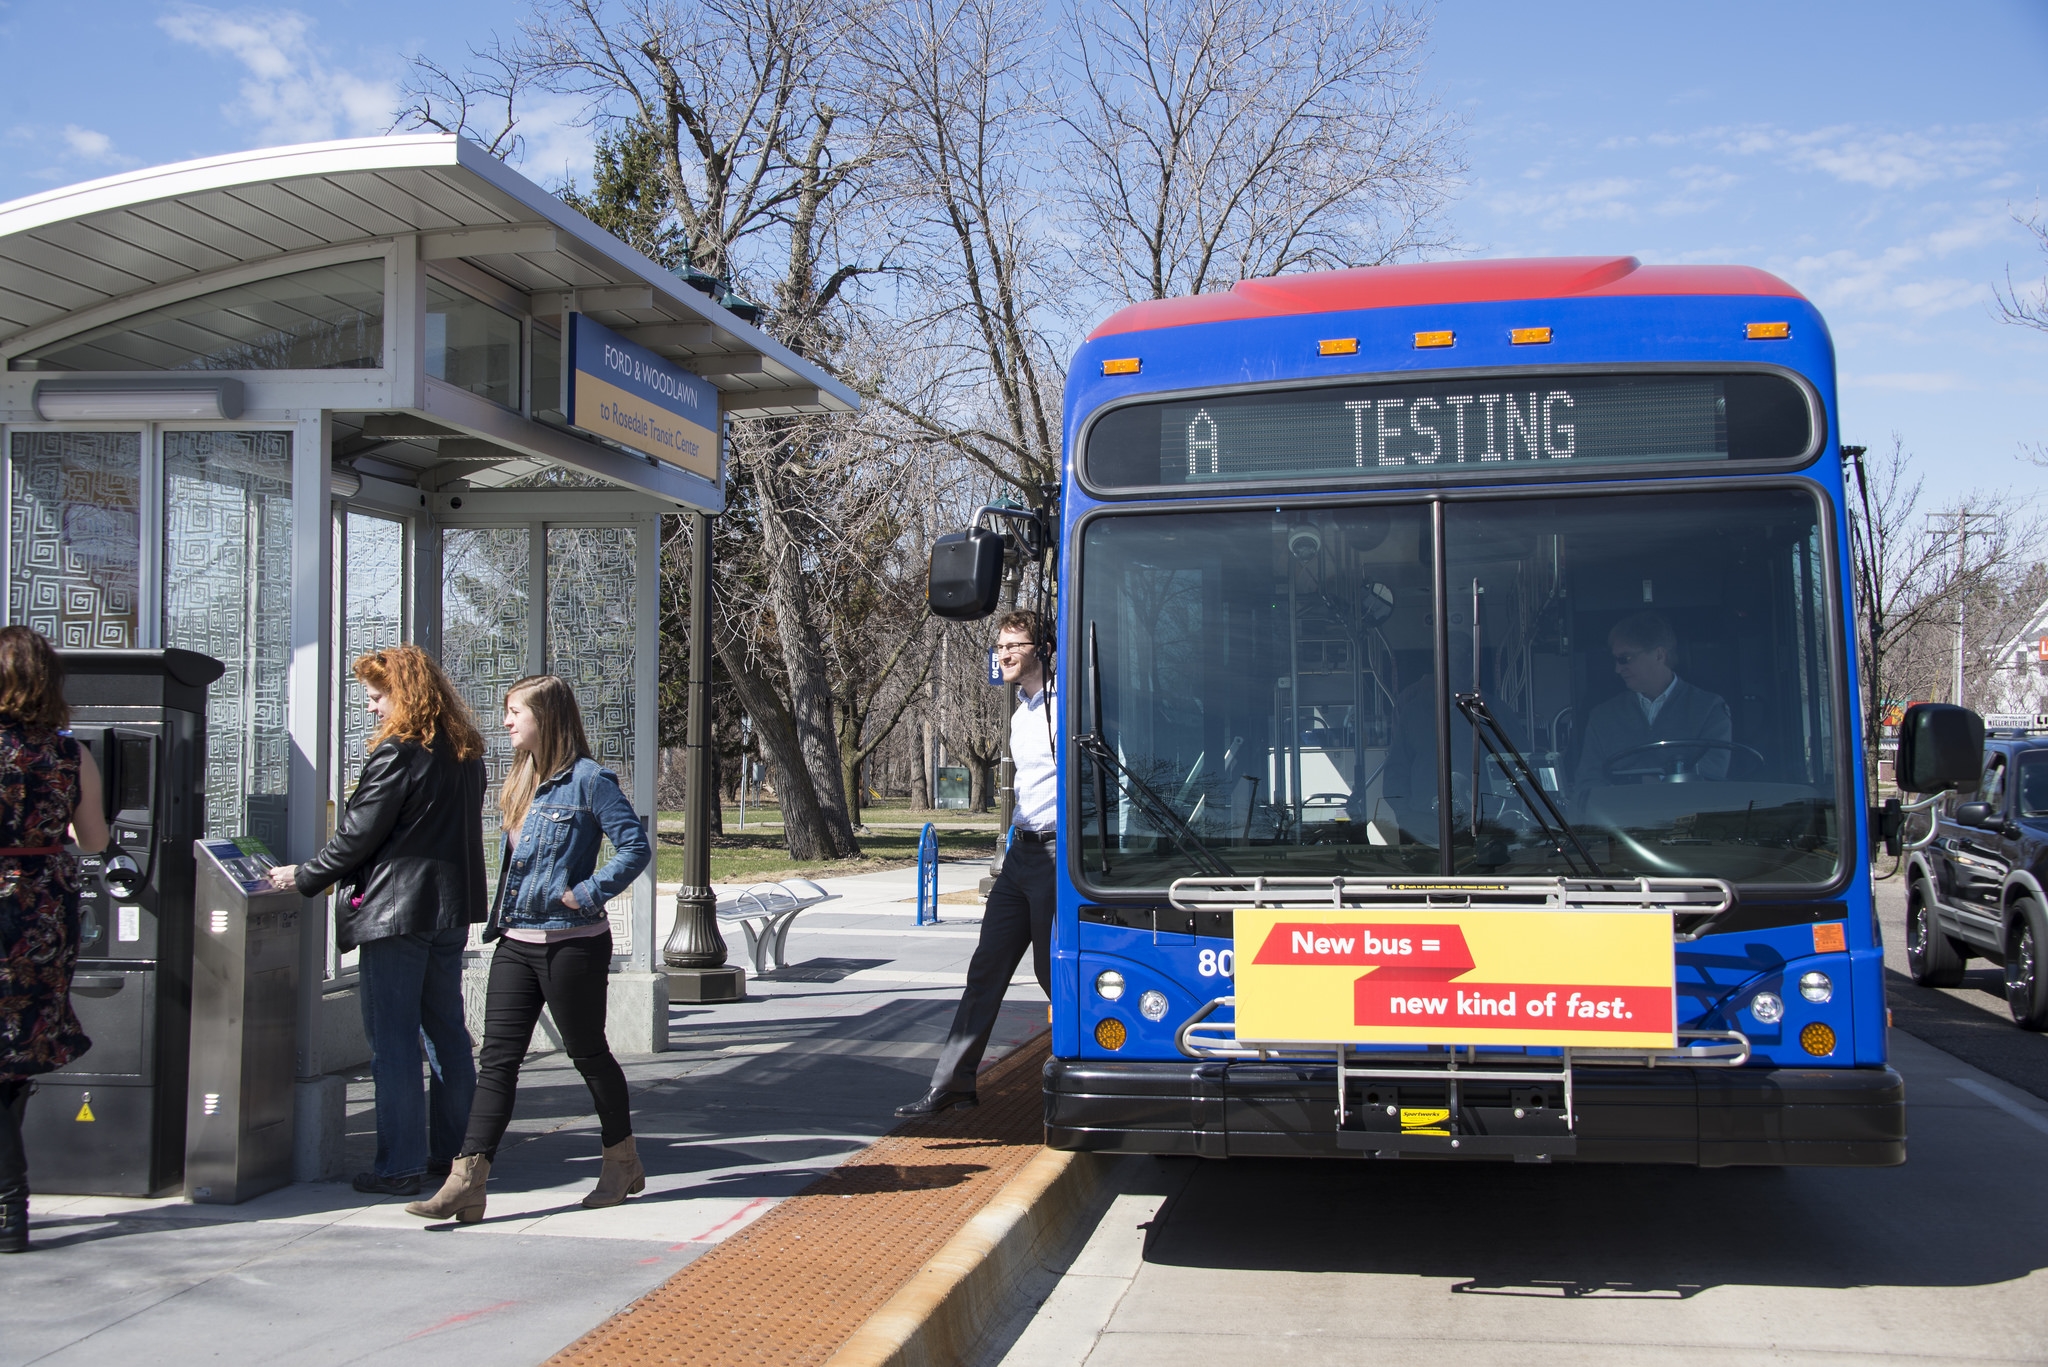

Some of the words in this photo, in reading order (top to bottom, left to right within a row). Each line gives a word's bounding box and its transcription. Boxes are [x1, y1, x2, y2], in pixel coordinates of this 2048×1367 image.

[605, 344, 632, 376] FORD
[634, 360, 641, 383] &
[642, 362, 698, 409] WOODLAWN
[600, 402, 610, 421] to
[613, 402, 648, 437] Rosedale
[649, 418, 674, 448] Transit
[675, 431, 700, 458] Center
[1188, 408, 1218, 474] A
[1345, 390, 1576, 467] TESTING
[991, 652, 999, 679] BUS
[123, 831, 138, 839] Bills
[1291, 931, 1355, 955] New
[1364, 930, 1412, 956] bus
[1421, 939, 1440, 951] =
[1390, 996, 1448, 1015] new
[1457, 990, 1516, 1016] kind
[1526, 992, 1556, 1017] of
[1566, 992, 1633, 1019] fast.
